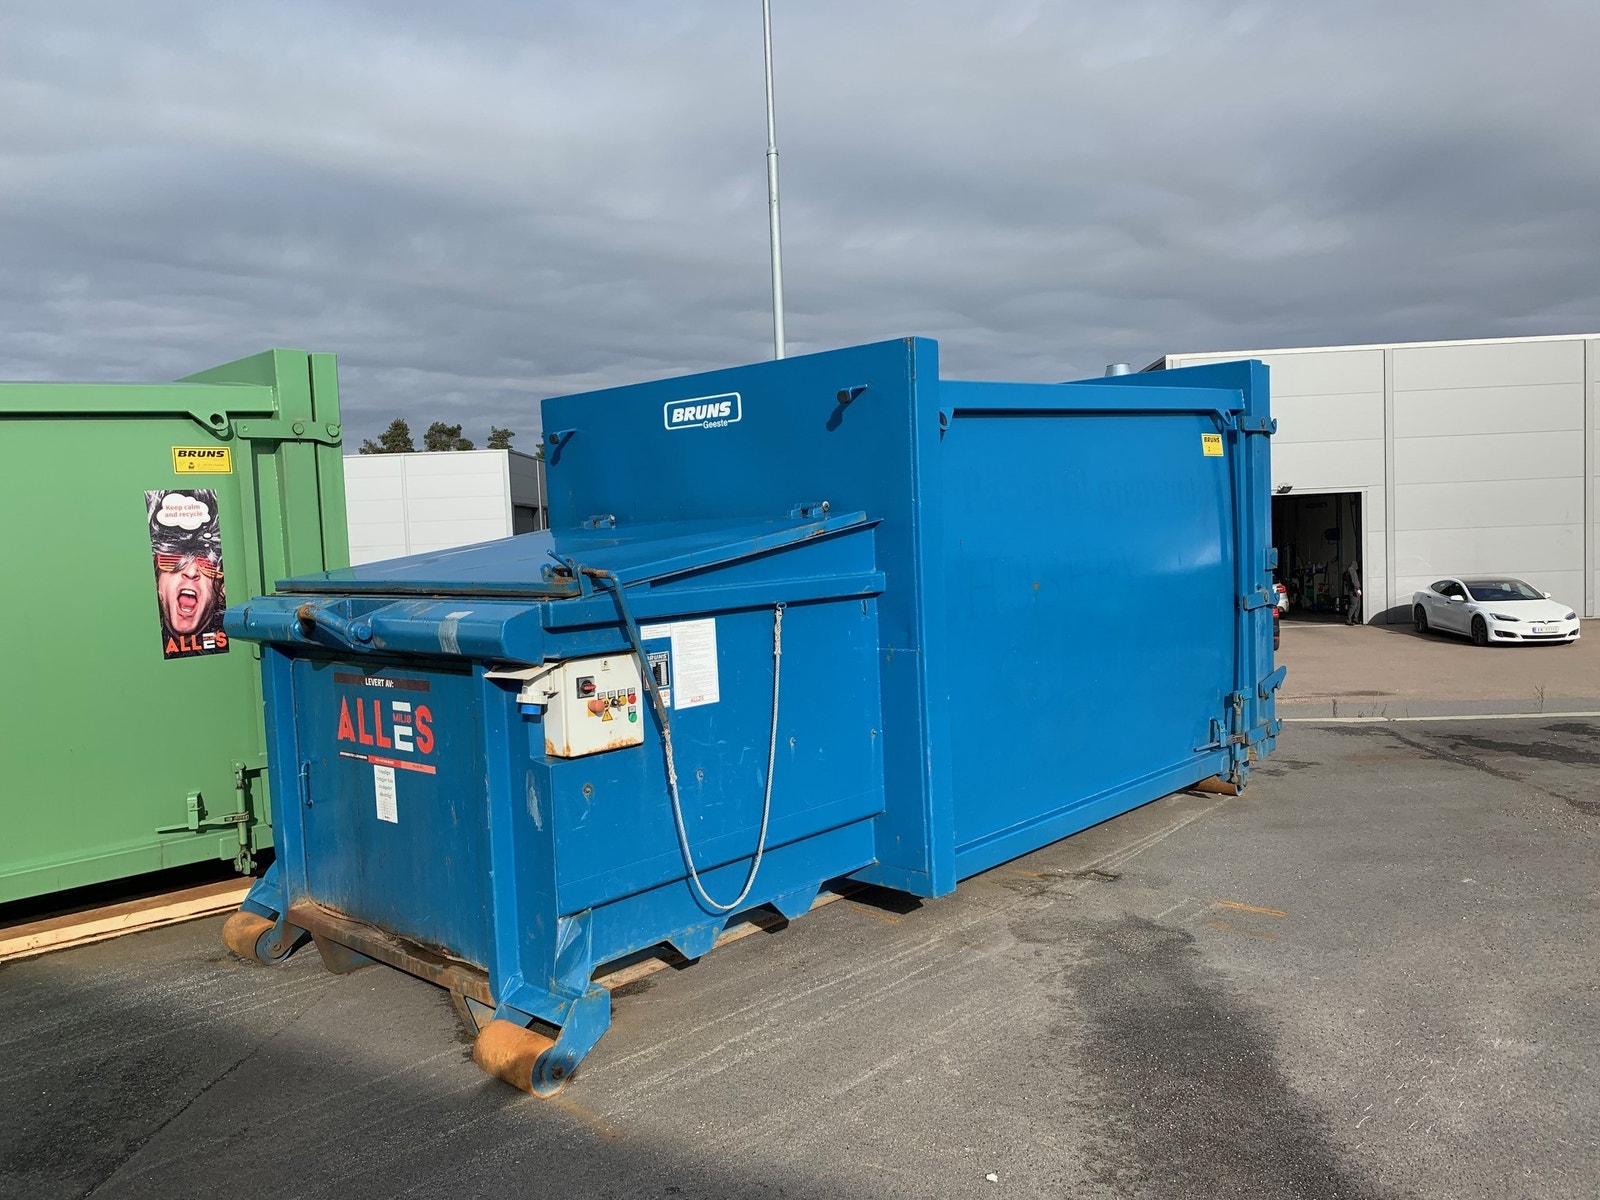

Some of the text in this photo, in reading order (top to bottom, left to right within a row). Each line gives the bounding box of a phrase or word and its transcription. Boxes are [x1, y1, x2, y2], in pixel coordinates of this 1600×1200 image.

[672, 401, 732, 423] BRUNS
[702, 419, 728, 429] Geeste
[177, 450, 225, 458] BRUNS
[165, 631, 227, 653] ALLES
[365, 677, 394, 688] LEVERT AV:
[392, 712, 412, 724] MILJØ
[337, 694, 435, 755] ALLES
